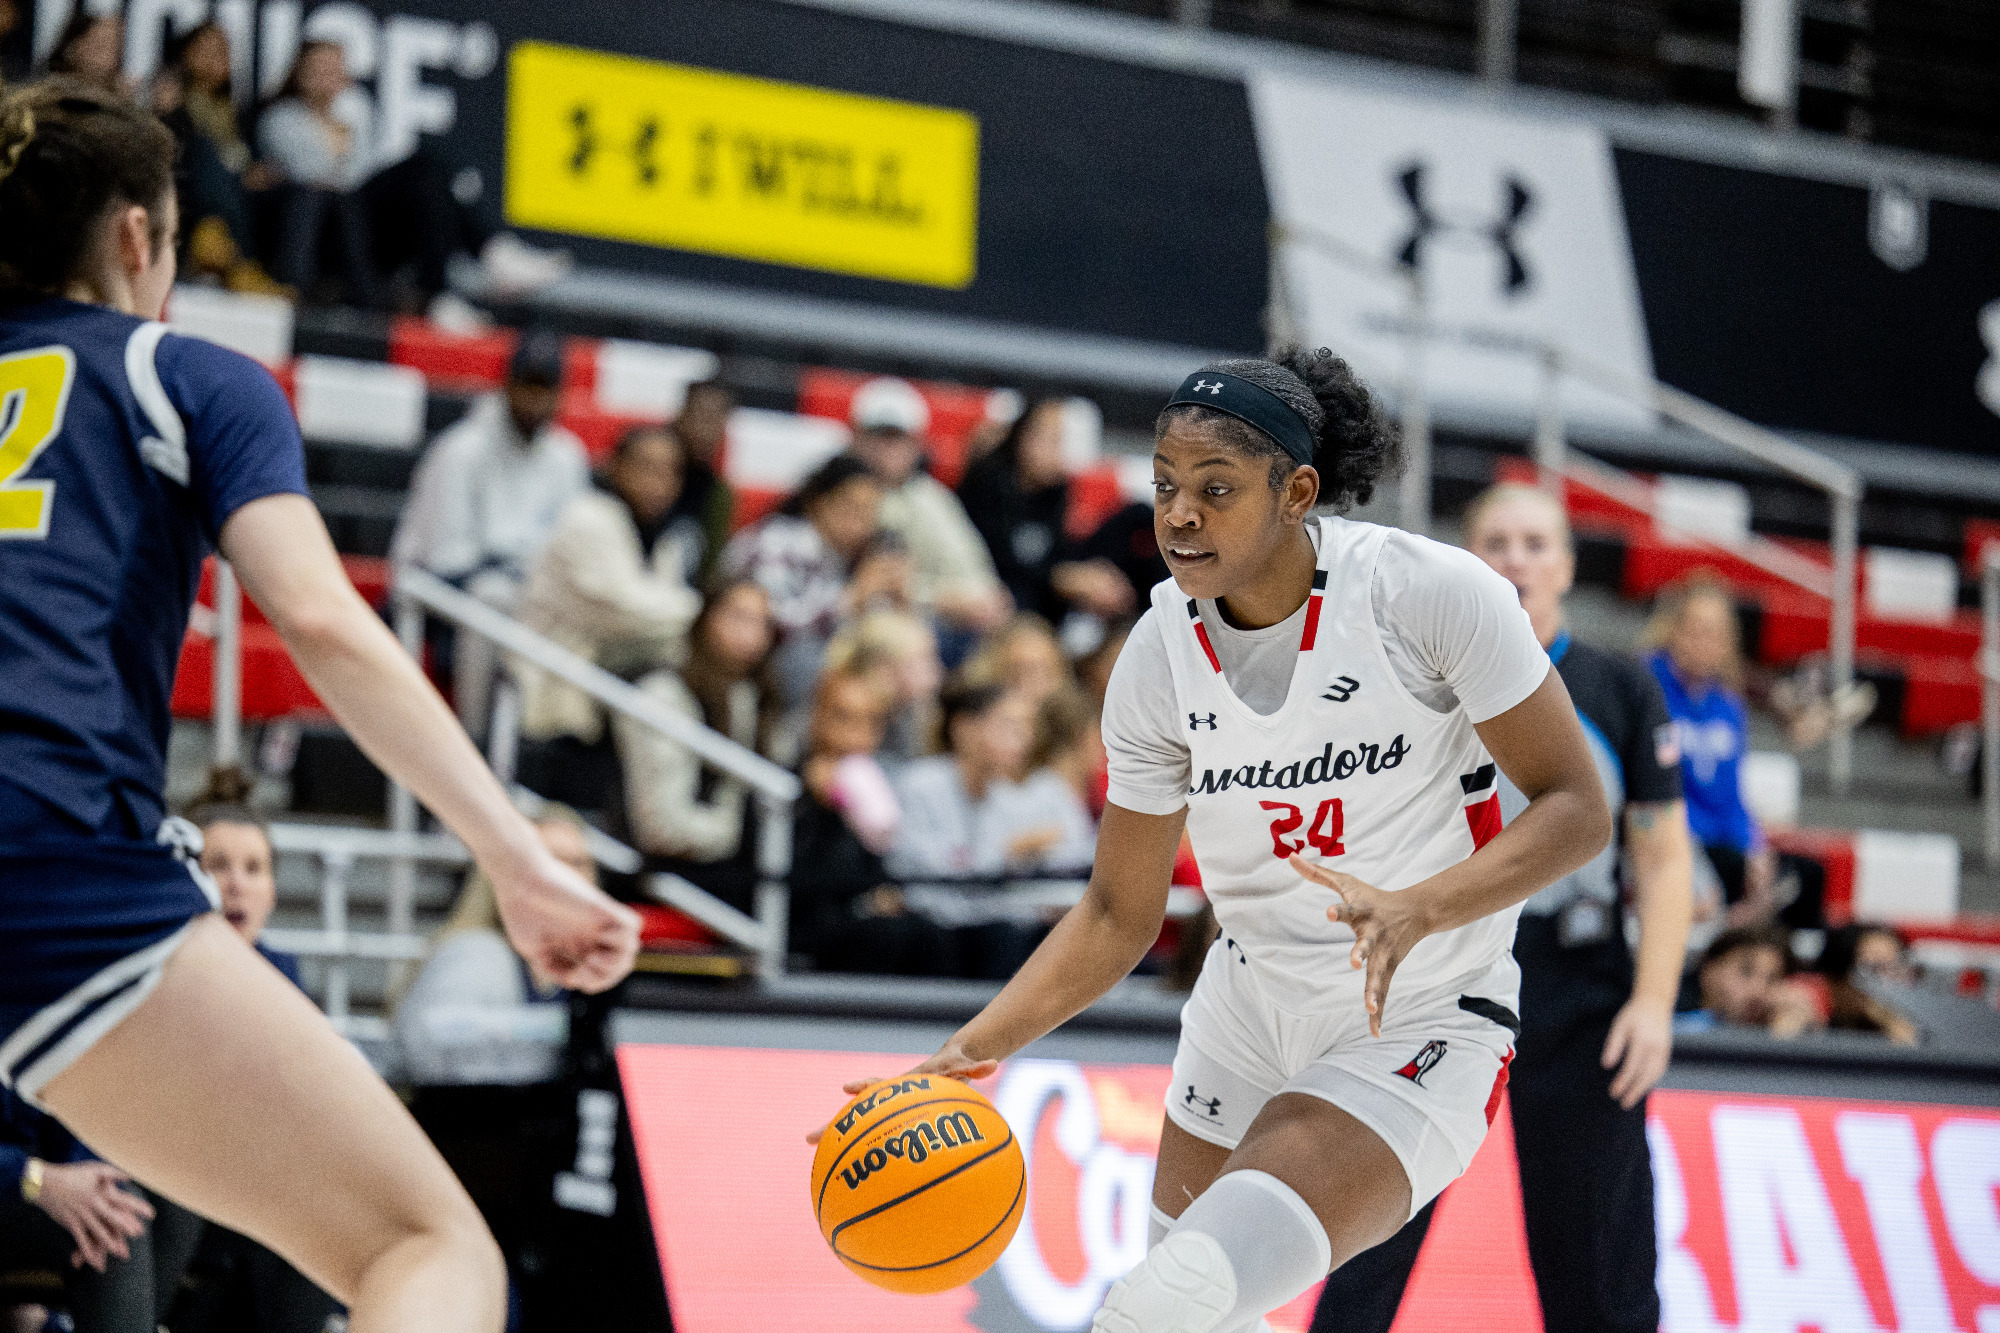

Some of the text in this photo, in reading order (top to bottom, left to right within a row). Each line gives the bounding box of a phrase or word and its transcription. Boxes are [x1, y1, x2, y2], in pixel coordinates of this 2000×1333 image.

[1188, 733, 1411, 796] Matadors
[1259, 797, 1346, 859] 24
[835, 1077, 933, 1136] NCAA
[840, 1110, 987, 1191] Wilson
